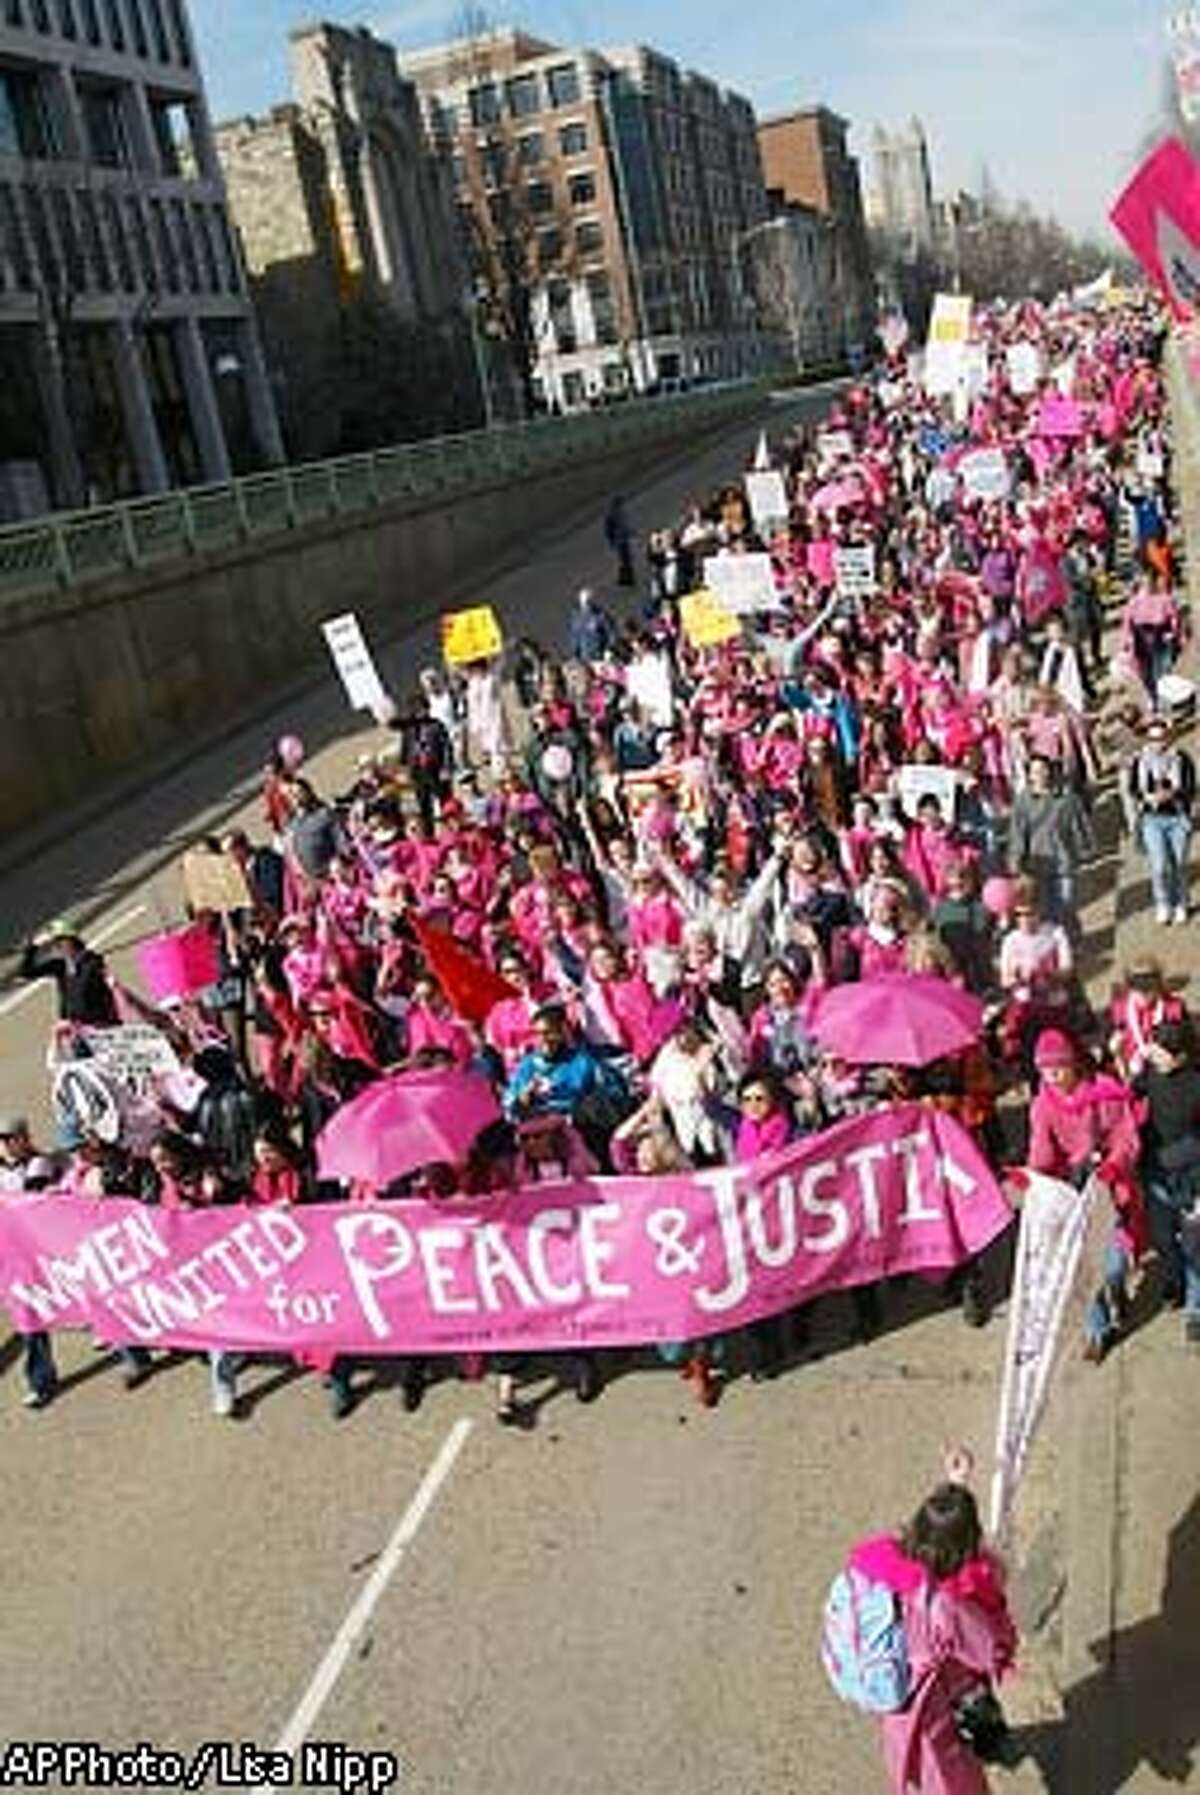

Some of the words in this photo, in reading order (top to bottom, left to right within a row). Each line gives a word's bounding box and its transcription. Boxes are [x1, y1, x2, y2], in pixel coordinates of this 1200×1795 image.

[10, 1206, 169, 1321] WMEN
[106, 1208, 305, 1338] UNITED
[266, 1285, 340, 1326] for
[334, 1204, 631, 1339] PEACE
[646, 1207, 701, 1276] &
[693, 1130, 977, 1311] JUSTI
